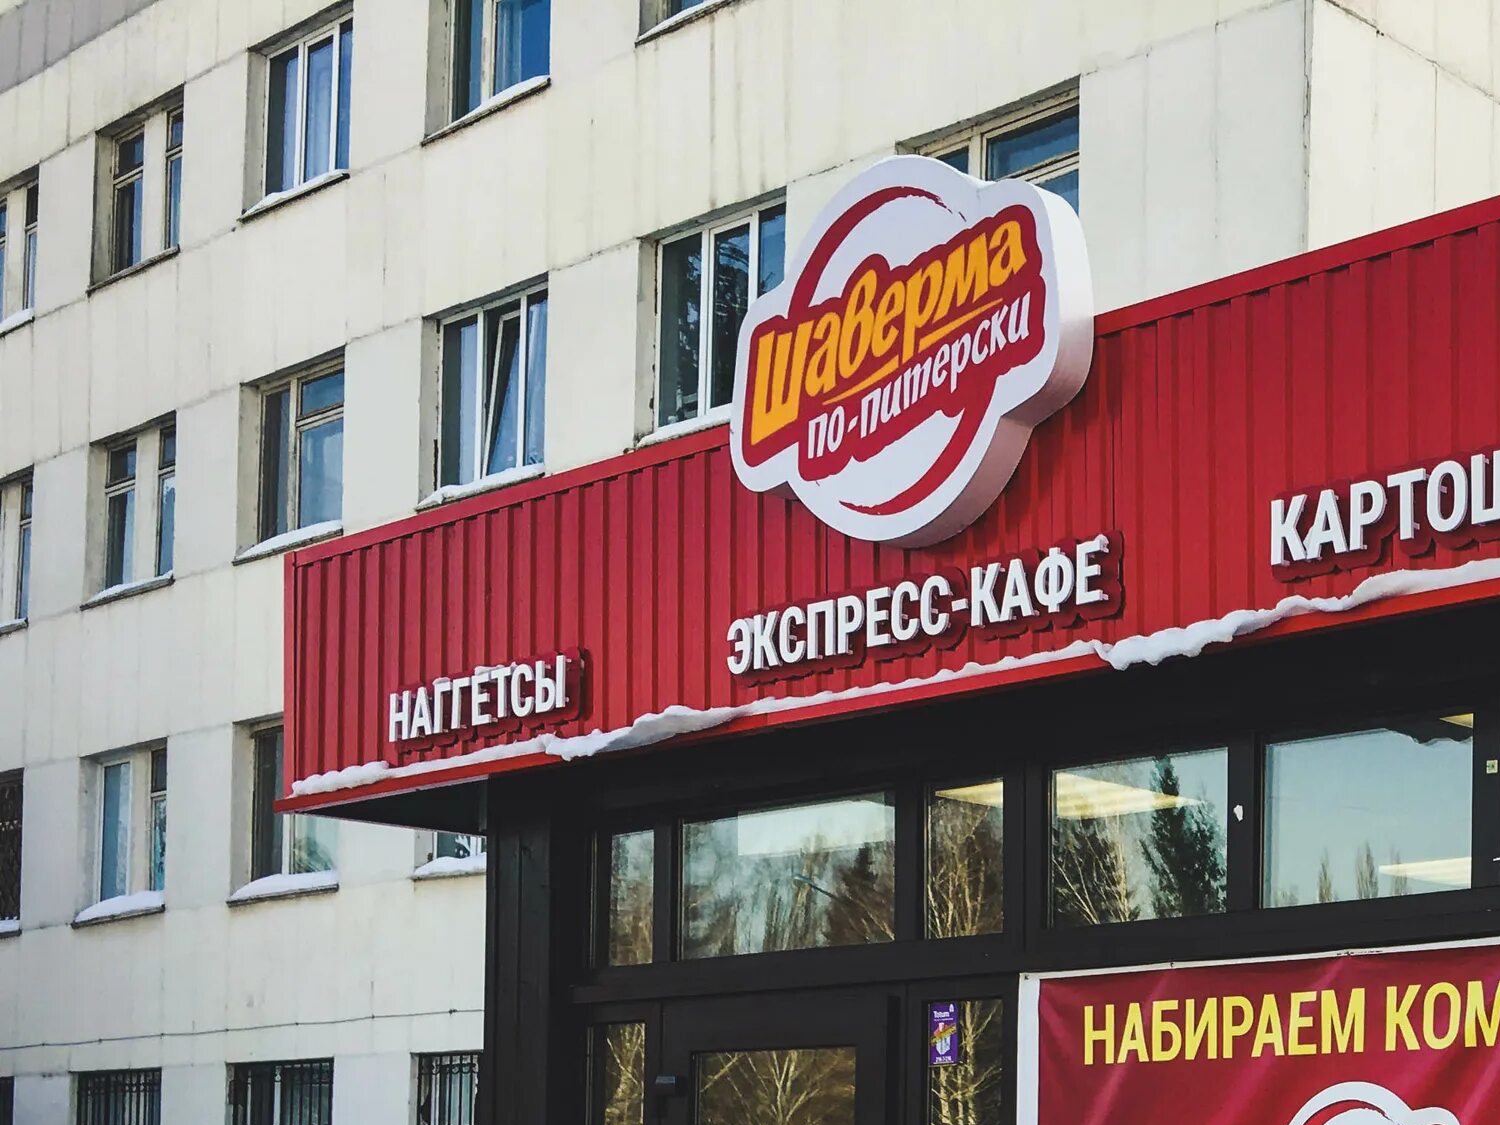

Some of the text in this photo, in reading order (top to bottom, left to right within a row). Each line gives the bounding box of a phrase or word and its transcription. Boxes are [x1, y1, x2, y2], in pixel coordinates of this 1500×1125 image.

[751, 220, 1027, 446] Шаверма
[808, 291, 1031, 459] по-питерски
[727, 534, 1109, 675] ЭКСПРЕСС-КАФЕ
[388, 654, 567, 743] НАГГЕТСЫ
[1083, 987, 1365, 1065] НАБИРАЕМ
